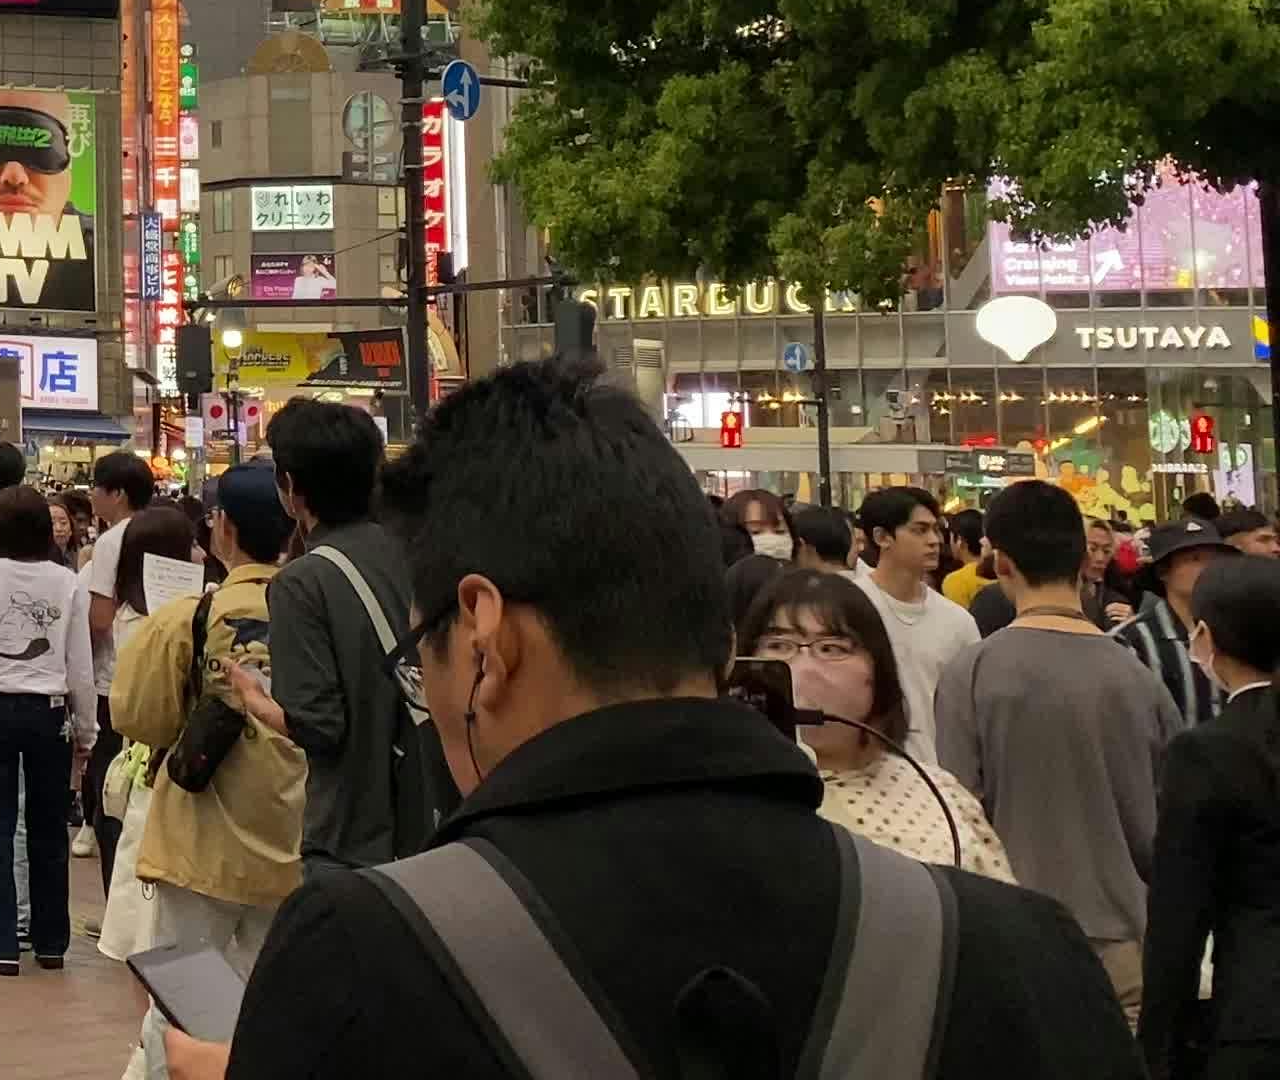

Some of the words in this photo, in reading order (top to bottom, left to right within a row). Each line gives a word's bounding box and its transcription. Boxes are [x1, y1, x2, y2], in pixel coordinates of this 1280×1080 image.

[68, 103, 91, 158] 再び
[422, 115, 444, 229] カラオケ
[274, 191, 331, 207] れいわ
[256, 211, 331, 226] クリニック
[1076, 326, 1232, 350] TSUTAYA
